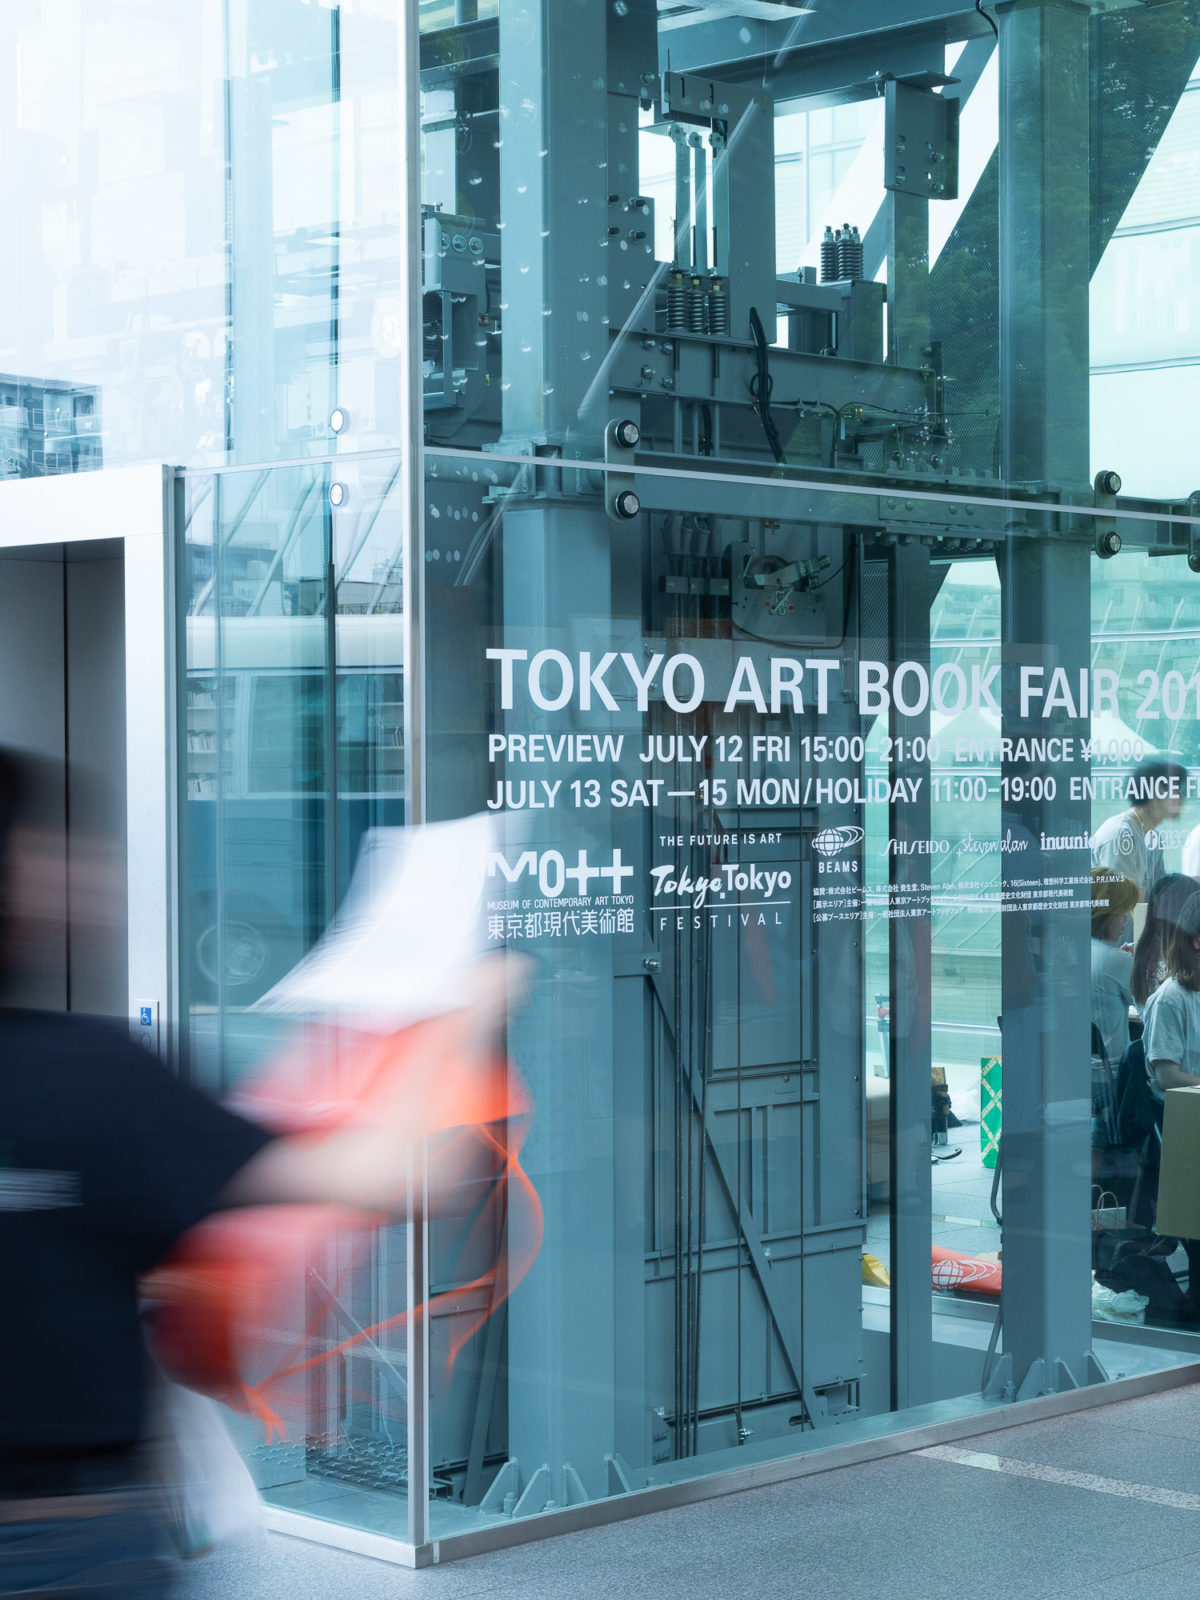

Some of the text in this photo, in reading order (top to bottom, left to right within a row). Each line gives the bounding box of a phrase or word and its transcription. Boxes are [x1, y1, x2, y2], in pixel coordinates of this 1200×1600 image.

[486, 649, 705, 714] TOKYO
[723, 656, 840, 715] ART
[858, 661, 1003, 718] BOOK
[1019, 666, 1120, 720] FAIR
[488, 733, 624, 763] PREVIEW
[639, 734, 707, 763] JULY
[715, 735, 743, 763] 12
[752, 735, 791, 762] FRI
[955, 737, 1074, 763] ENTRANCE
[1081, 737, 1145, 764] ¥1,000
[486, 780, 562, 810] JULY
[570, 780, 601, 808] 13
[1069, 776, 1180, 801] ENTRANCE
[660, 833, 782, 847] THE FUTURE IS ART
[878, 838, 950, 857] SHISEIDO
[818, 861, 858, 874] BEAMS
[649, 864, 792, 909] Tokyo Tokyo
[487, 894, 634, 911] MUSEUM OF CONTEMPORARY ART TOKYO
[487, 908, 634, 940] 東京都現代美術館
[660, 912, 783, 931] FESTIVAL
